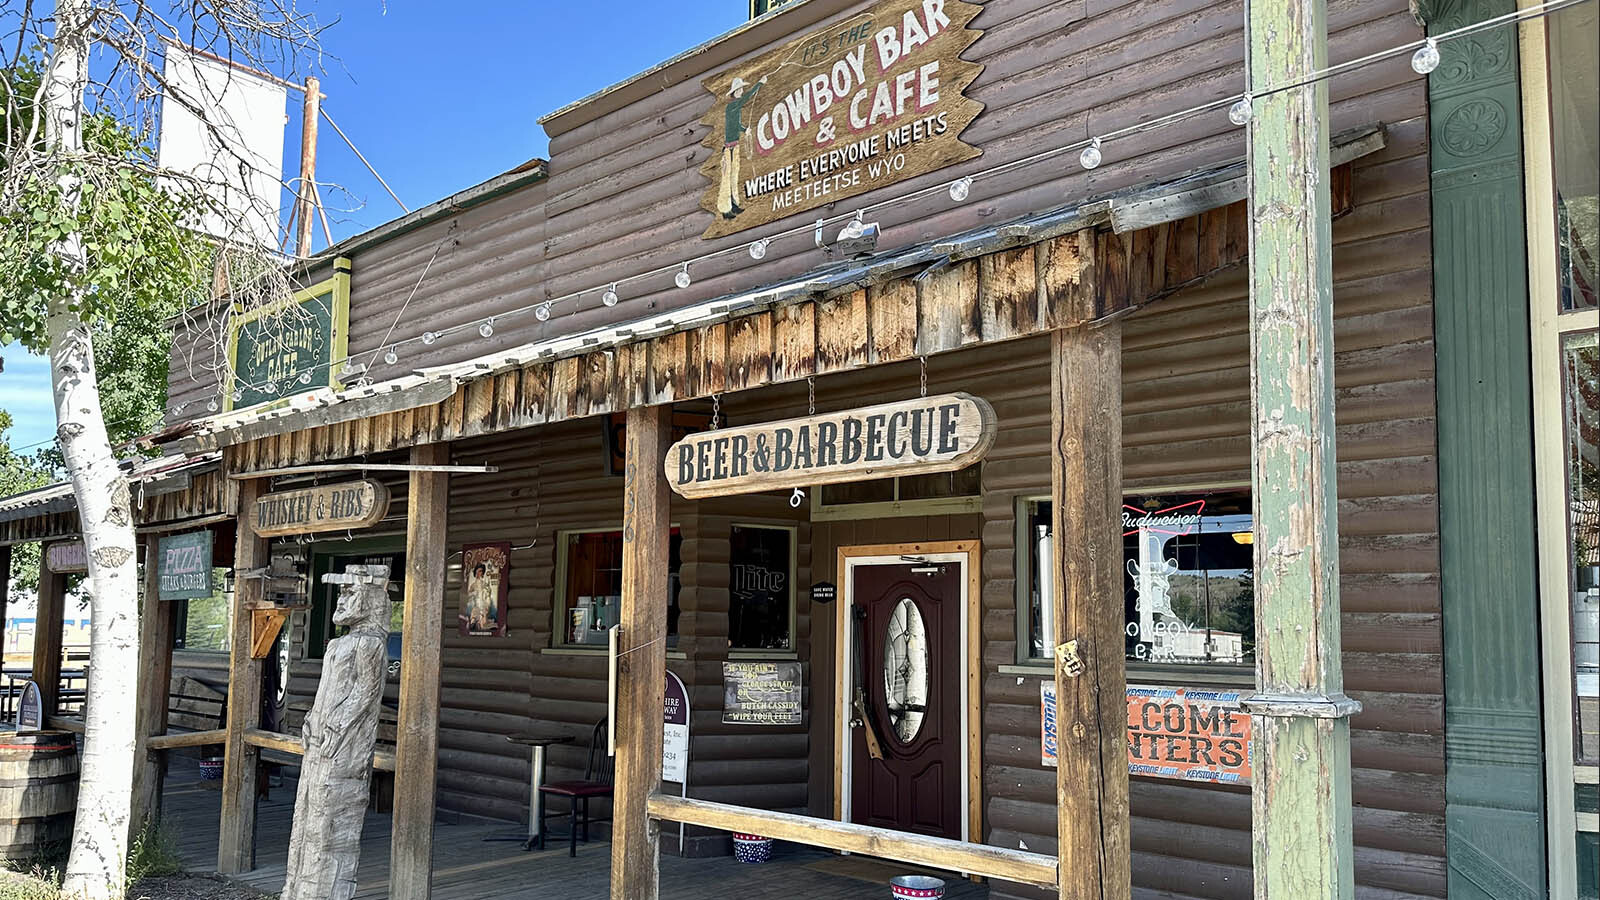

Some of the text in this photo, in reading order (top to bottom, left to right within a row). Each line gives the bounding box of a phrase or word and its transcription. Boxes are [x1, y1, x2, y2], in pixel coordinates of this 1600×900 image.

[838, 21, 872, 48] THE
[756, 0, 951, 152] COWBOY BAR
[815, 61, 940, 144] & CAFE
[745, 112, 948, 198] WHERE EVERYONE MEETS
[772, 154, 905, 211] MEETEETSE WYO
[267, 352, 298, 383] CAFE
[258, 487, 365, 528] WHISKEY & RIBS
[164, 546, 204, 575] PIZZA
[733, 564, 785, 599] Lite
[1124, 621, 1194, 637] OWBOY
[741, 702, 799, 710] BUTCH CASSIDY
[1126, 688, 1177, 699] KEYSTONE LIGHT
[1185, 690, 1240, 702] KEYSTONE LIGHT
[753, 712, 774, 722] YOUR
[1128, 763, 1159, 774] KEYSTONE
[1186, 769, 1240, 781] KEYSTONE LIGHT
